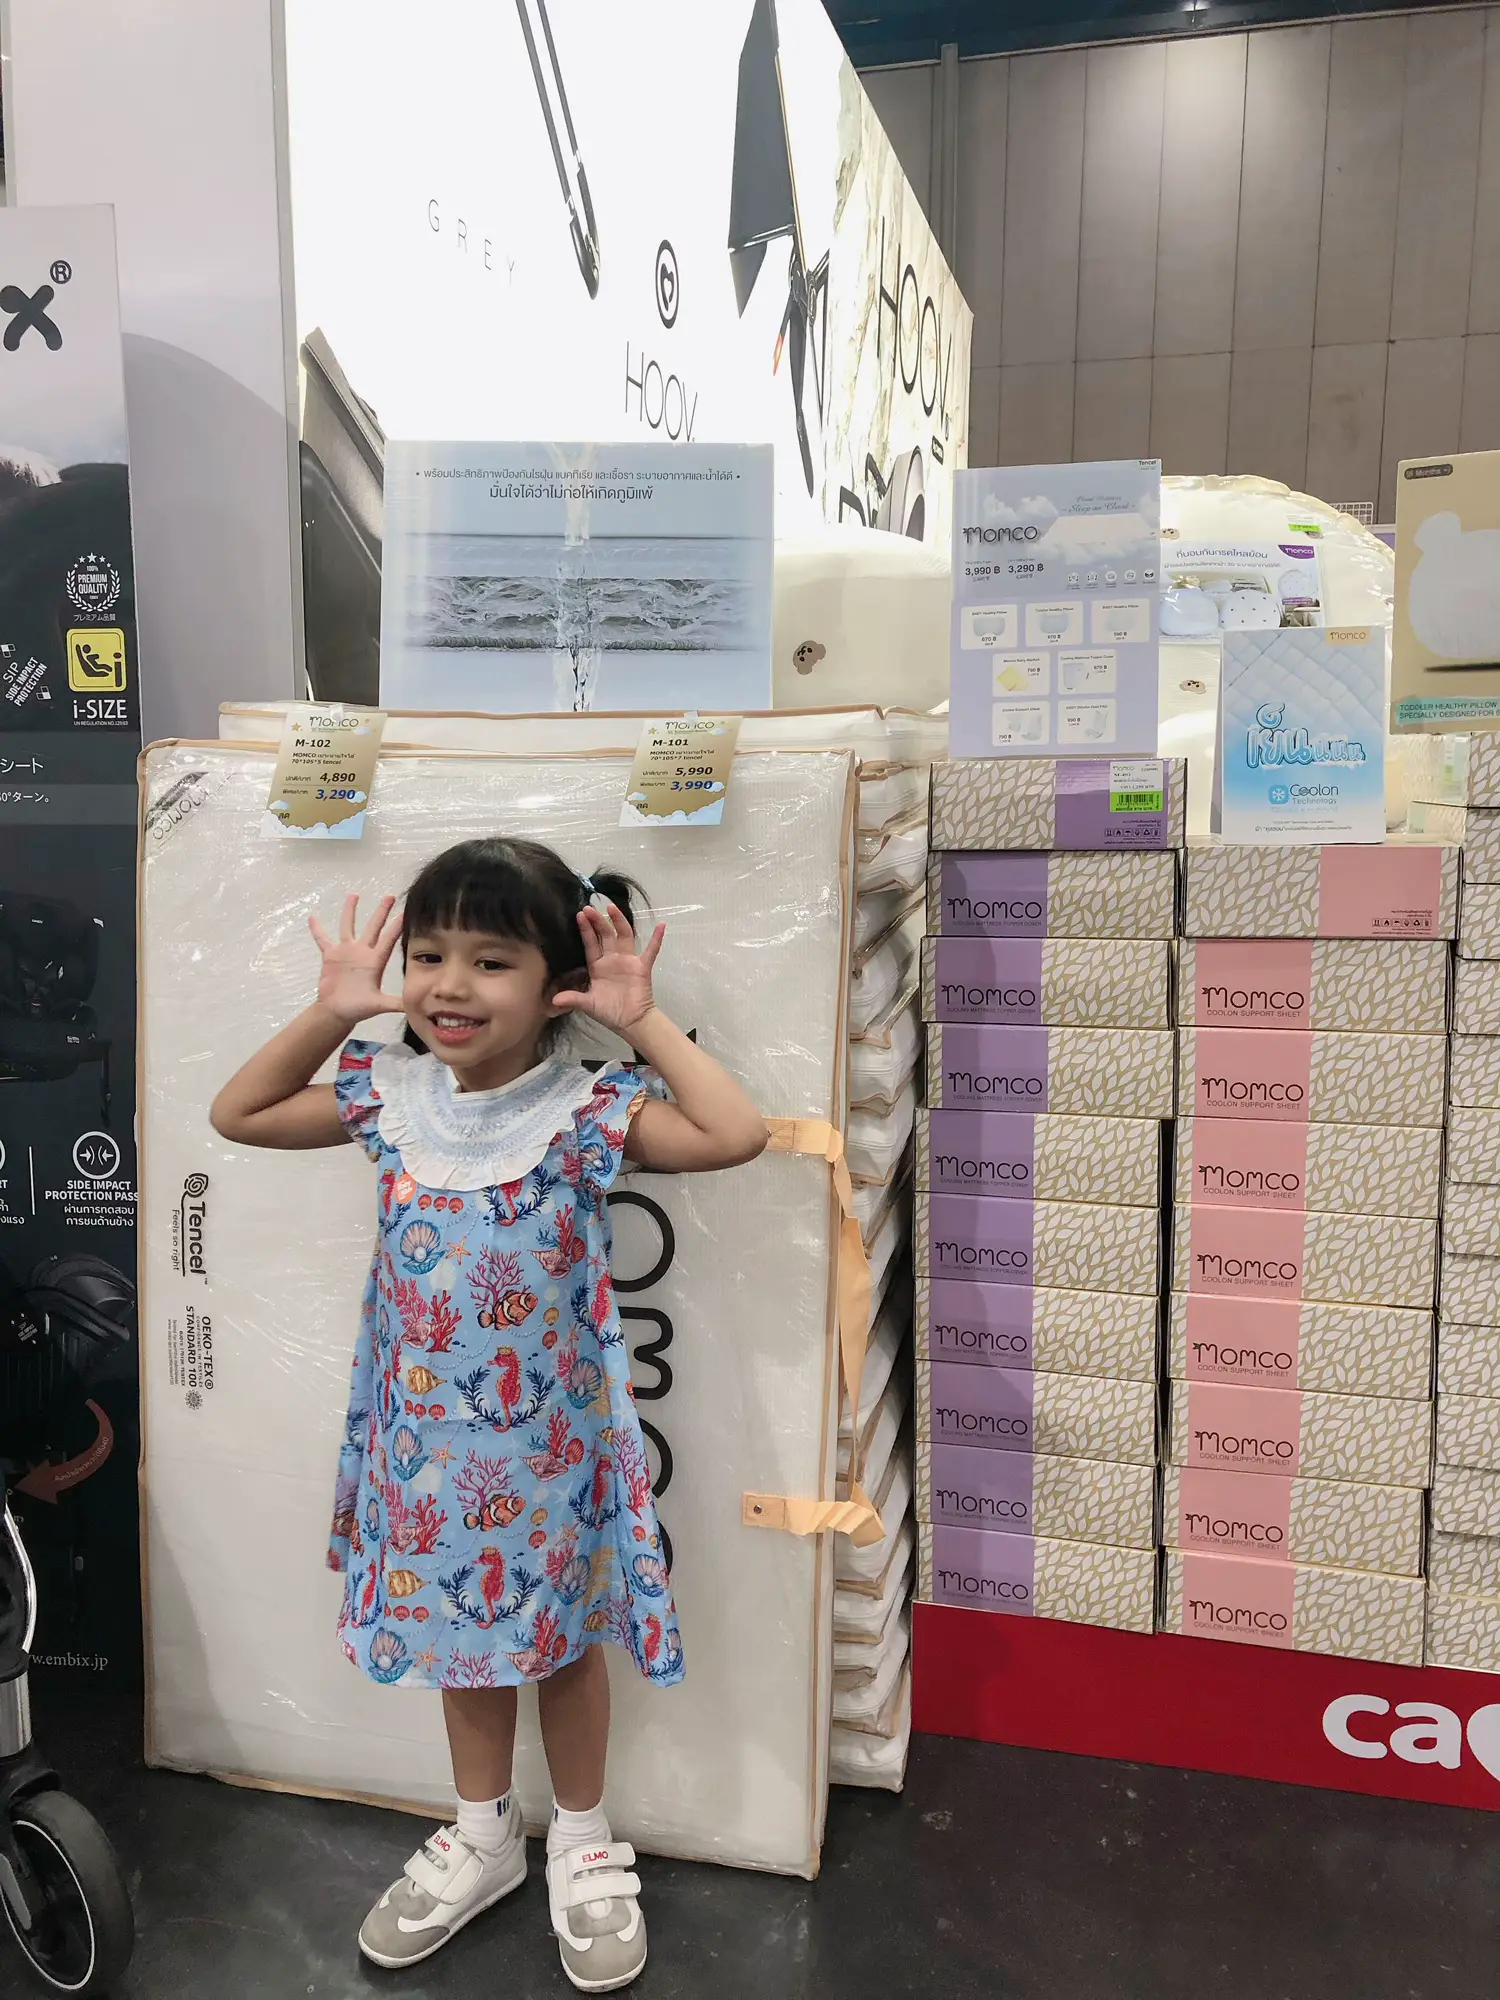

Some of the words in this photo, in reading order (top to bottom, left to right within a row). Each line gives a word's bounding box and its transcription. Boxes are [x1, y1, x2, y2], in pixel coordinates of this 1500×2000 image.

[427, 199, 515, 286] GREY
[876, 216, 952, 431] HOOV
[489, 481, 653, 504] มั่นใจได้ว่าไม่ก่อให้เกิดภูมิแพ้
[965, 566, 992, 576] 3,990
[1007, 564, 1035, 574] 3,290
[78, 574, 107, 583] PREMIUM
[78, 584, 108, 594] QUALITY
[73, 613, 116, 622] プレミアム品質
[3, 662, 19, 684] SIP
[16, 656, 39, 684] IMPACT
[13, 663, 48, 707] PROTECTION
[73, 699, 128, 719] i-SIZE
[1400, 703, 1434, 711] TODDLER
[1400, 711, 1437, 719] SPECIALLY
[1439, 710, 1477, 718] DESIGNED
[295, 738, 331, 748] M-102
[652, 738, 689, 746] M-101
[319, 771, 357, 784] 4,890
[675, 766, 713, 777] 5,990
[670, 780, 713, 791] 3,990
[315, 789, 357, 801] 3,290
[1292, 797, 1338, 805] Technology
[1206, 1009, 1239, 1017] COOLON
[1240, 1101, 1274, 1109] SUPPORT
[67, 1180, 91, 1189] SIDE
[93, 1180, 131, 1190] IMPACT
[45, 1191, 112, 1200] PROTECTION
[1203, 1187, 1235, 1196] COOLON
[1236, 1189, 1270, 1197] SUPPORT
[1272, 1191, 1297, 1199] SHEET
[64, 1203, 135, 1214] ผ่านการทดสอบ
[66, 1216, 134, 1226] การชนด้านข้าง
[172, 1209, 180, 1234] Feels
[172, 1235, 178, 1247] so
[171, 1249, 180, 1271] right
[1201, 1275, 1233, 1284] COOLON
[1234, 1278, 1268, 1286] SUPPORT
[1270, 1280, 1295, 1288] SHEET
[185, 1305, 196, 1364] STANDARD
[1197, 1364, 1228, 1373] COOLON
[1230, 1366, 1264, 1375] SUPPORT
[1265, 1369, 1290, 1377] SHEET
[188, 1368, 197, 1387] 100
[1199, 1452, 1230, 1461] COOLON
[1232, 1454, 1265, 1464] SUPPORT
[1267, 1457, 1291, 1466] SHEET
[434, 1834, 451, 1853] ELMO
[582, 1851, 609, 1864] ELMO
